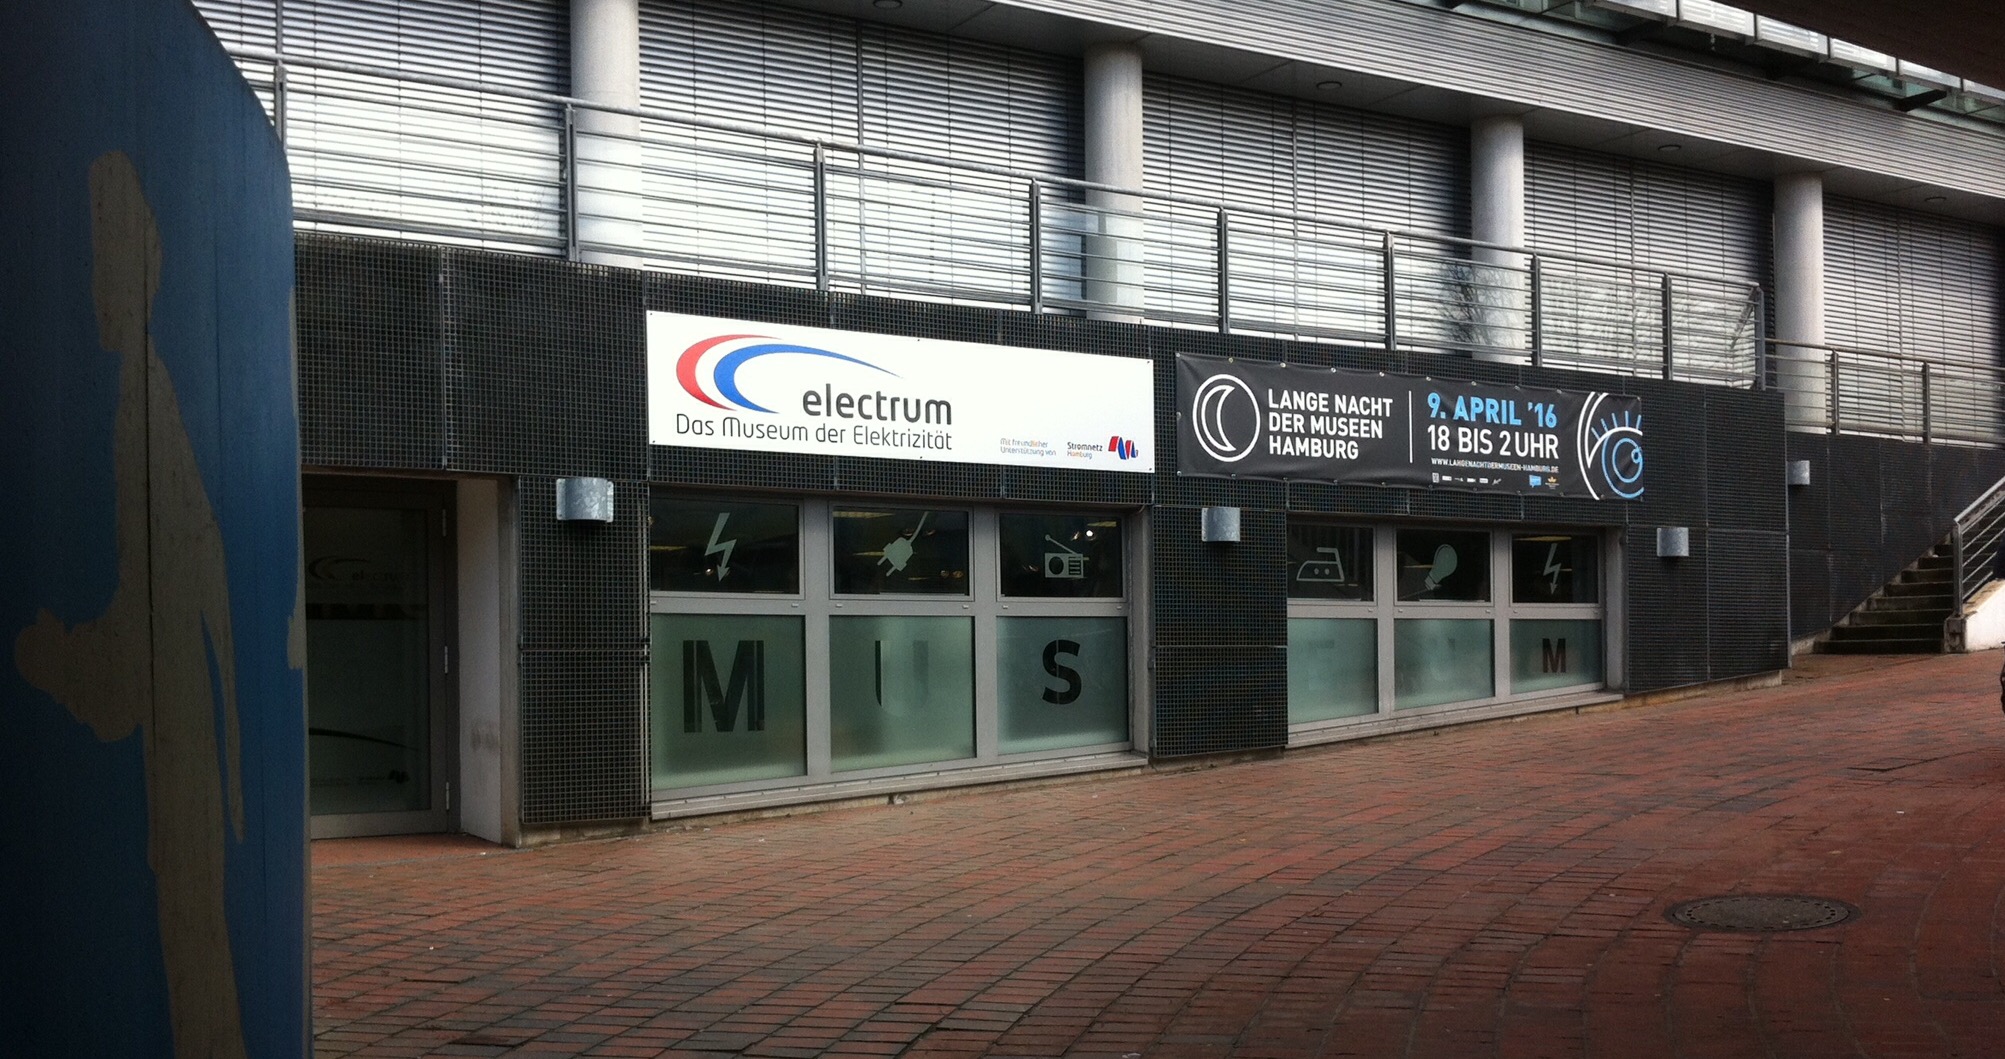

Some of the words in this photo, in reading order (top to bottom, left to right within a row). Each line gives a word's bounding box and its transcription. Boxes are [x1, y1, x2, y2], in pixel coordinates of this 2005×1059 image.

[802, 383, 952, 425] electrum
[1268, 388, 1330, 413] LANGE
[1334, 393, 1393, 417] NACHT
[1427, 392, 1446, 419] 9.
[1452, 395, 1522, 426] APRIL
[1527, 401, 1557, 428] '16
[676, 413, 715, 436] Das
[722, 416, 808, 442] Museum
[815, 423, 846, 443] der
[853, 425, 952, 450] Elektrizität
[1268, 411, 1305, 434] DER
[1310, 415, 1383, 439] MUSEEN
[1427, 424, 1450, 451] 18
[1457, 426, 1493, 455] BIS
[1067, 441, 1103, 452] Stromnetz
[1268, 434, 1359, 460] HAMBURG
